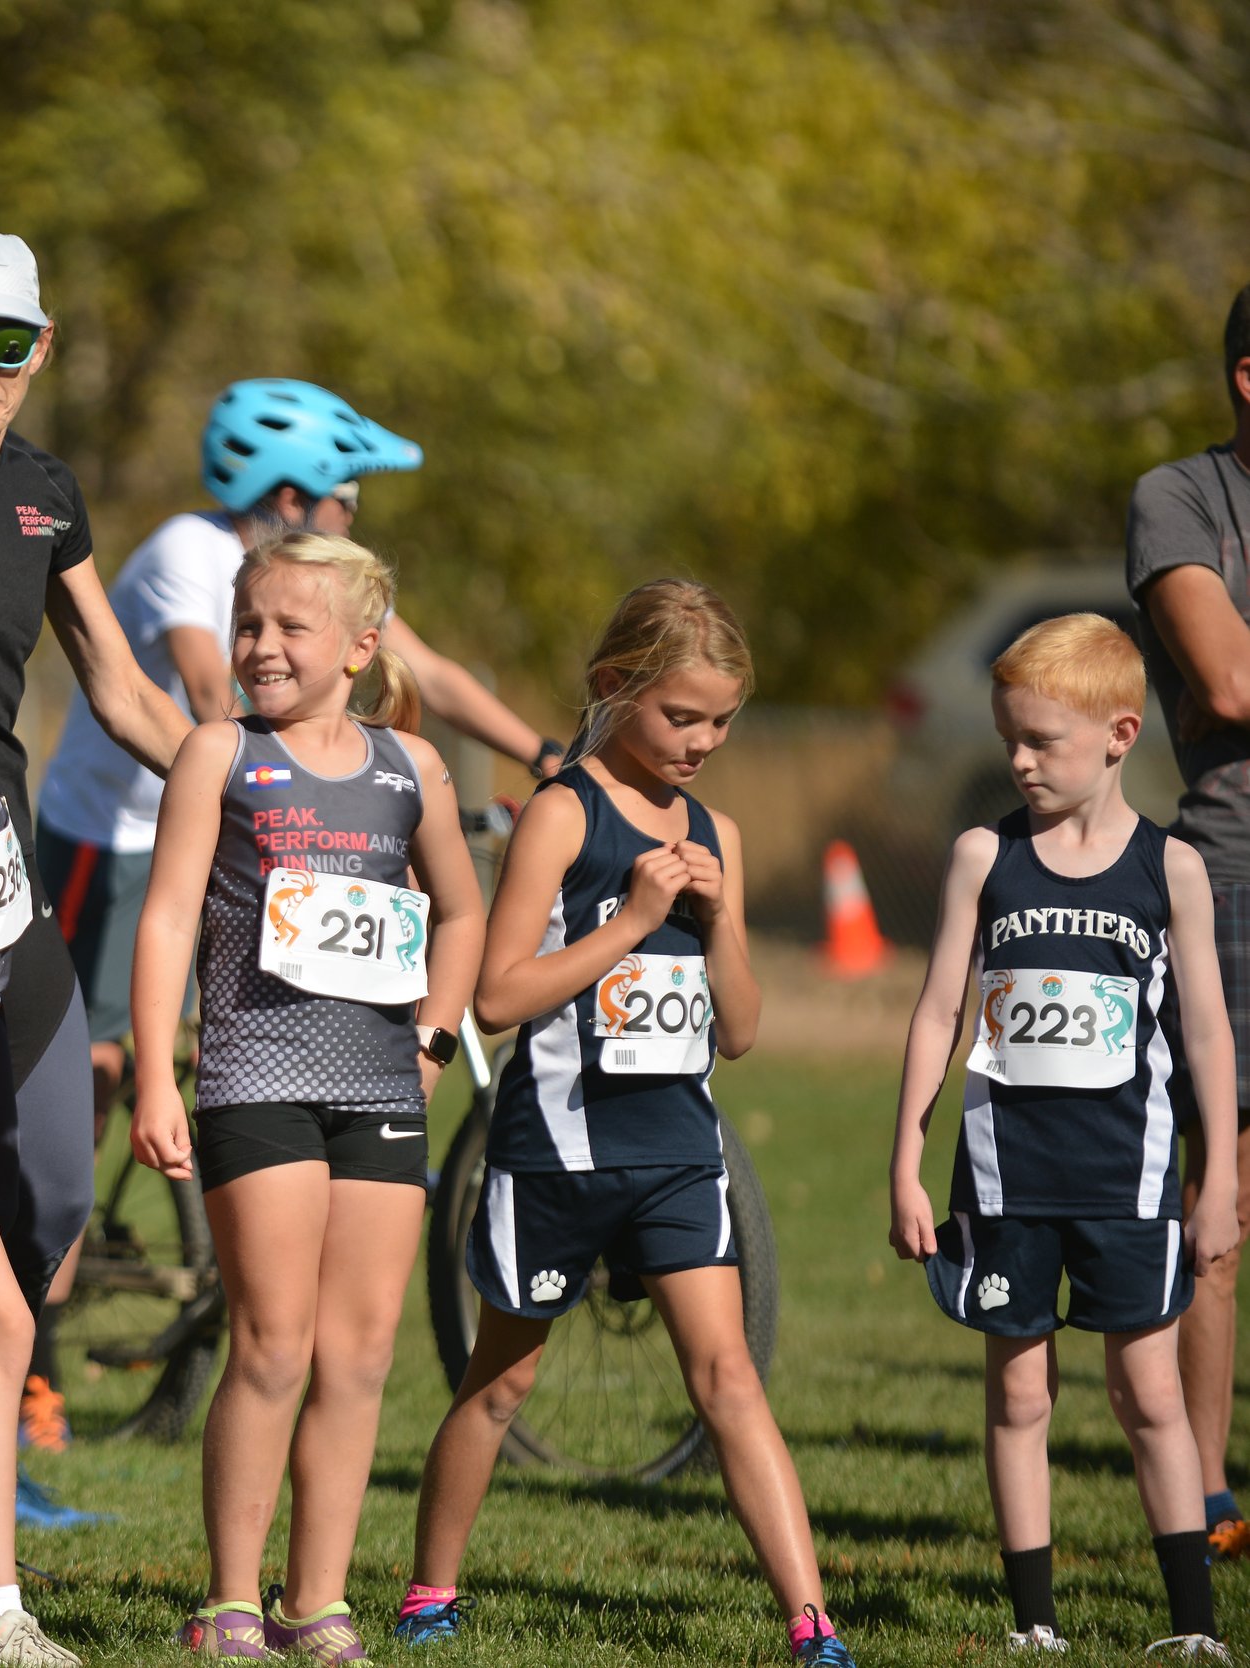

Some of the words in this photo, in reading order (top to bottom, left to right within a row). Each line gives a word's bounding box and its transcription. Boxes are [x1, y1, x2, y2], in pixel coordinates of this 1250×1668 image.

[253, 806, 325, 830] PEAK.
[317, 907, 387, 961] 231
[990, 906, 1151, 960] PANTHERS
[623, 989, 707, 1034] 200
[1008, 1001, 1098, 1047] 223
